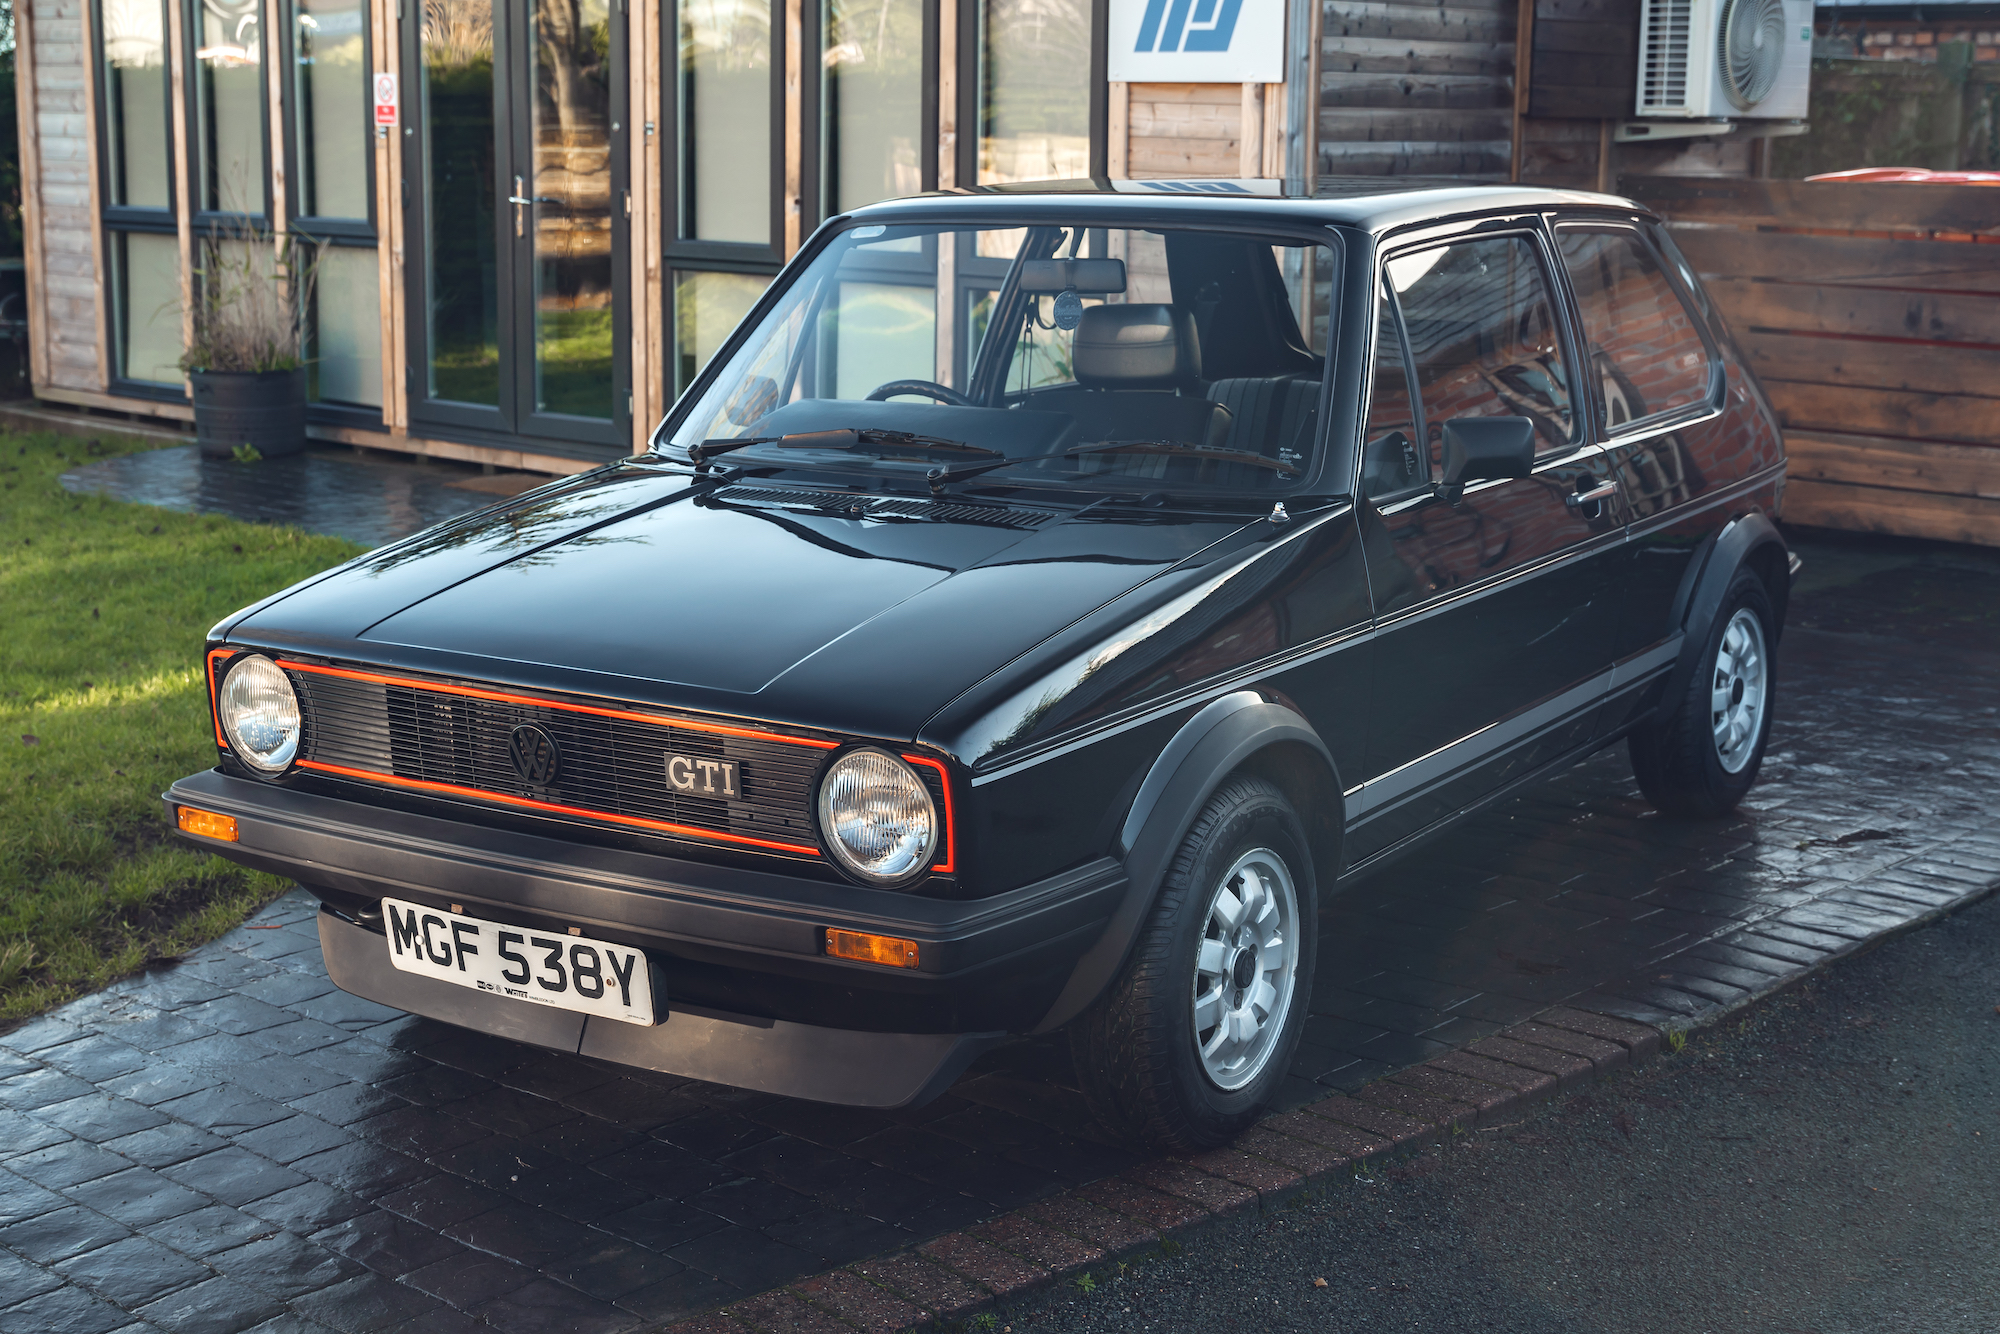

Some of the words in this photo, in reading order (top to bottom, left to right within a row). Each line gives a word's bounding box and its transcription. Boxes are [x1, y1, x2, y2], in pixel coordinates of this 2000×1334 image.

[668, 756, 735, 796] GTI
[388, 904, 480, 972] MGF
[498, 930, 637, 1007] 538Y
